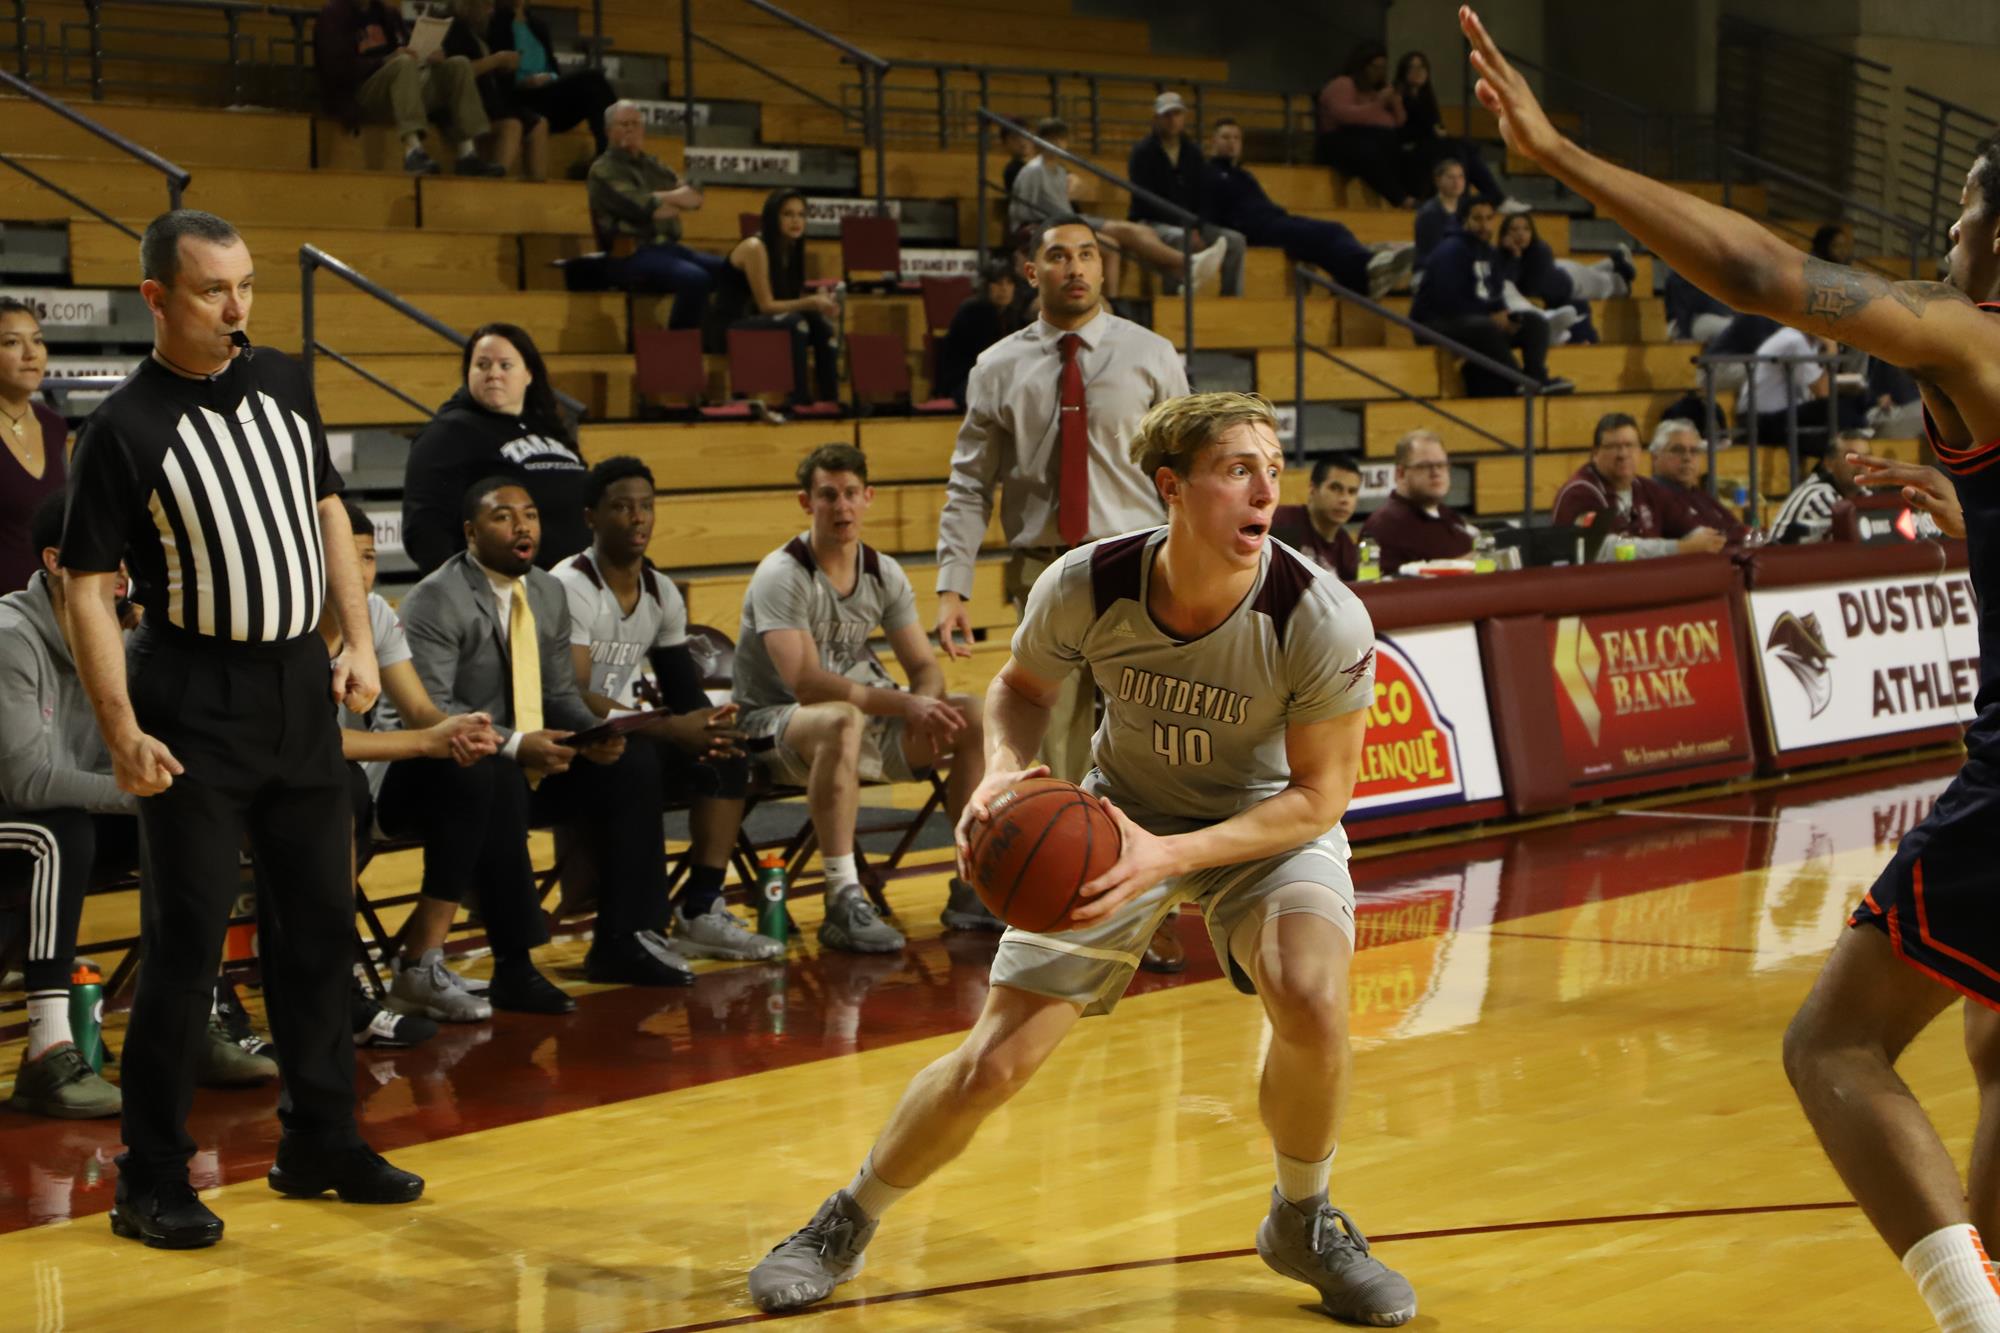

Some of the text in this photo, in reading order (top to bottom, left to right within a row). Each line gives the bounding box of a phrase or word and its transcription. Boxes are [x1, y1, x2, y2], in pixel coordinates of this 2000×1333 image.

[1601, 620, 1722, 675] FALCON
[1118, 665, 1253, 725] DUSTDEVILS
[1366, 680, 1412, 729] CO
[1610, 667, 1696, 715] BANK
[1152, 719, 1213, 767] 40
